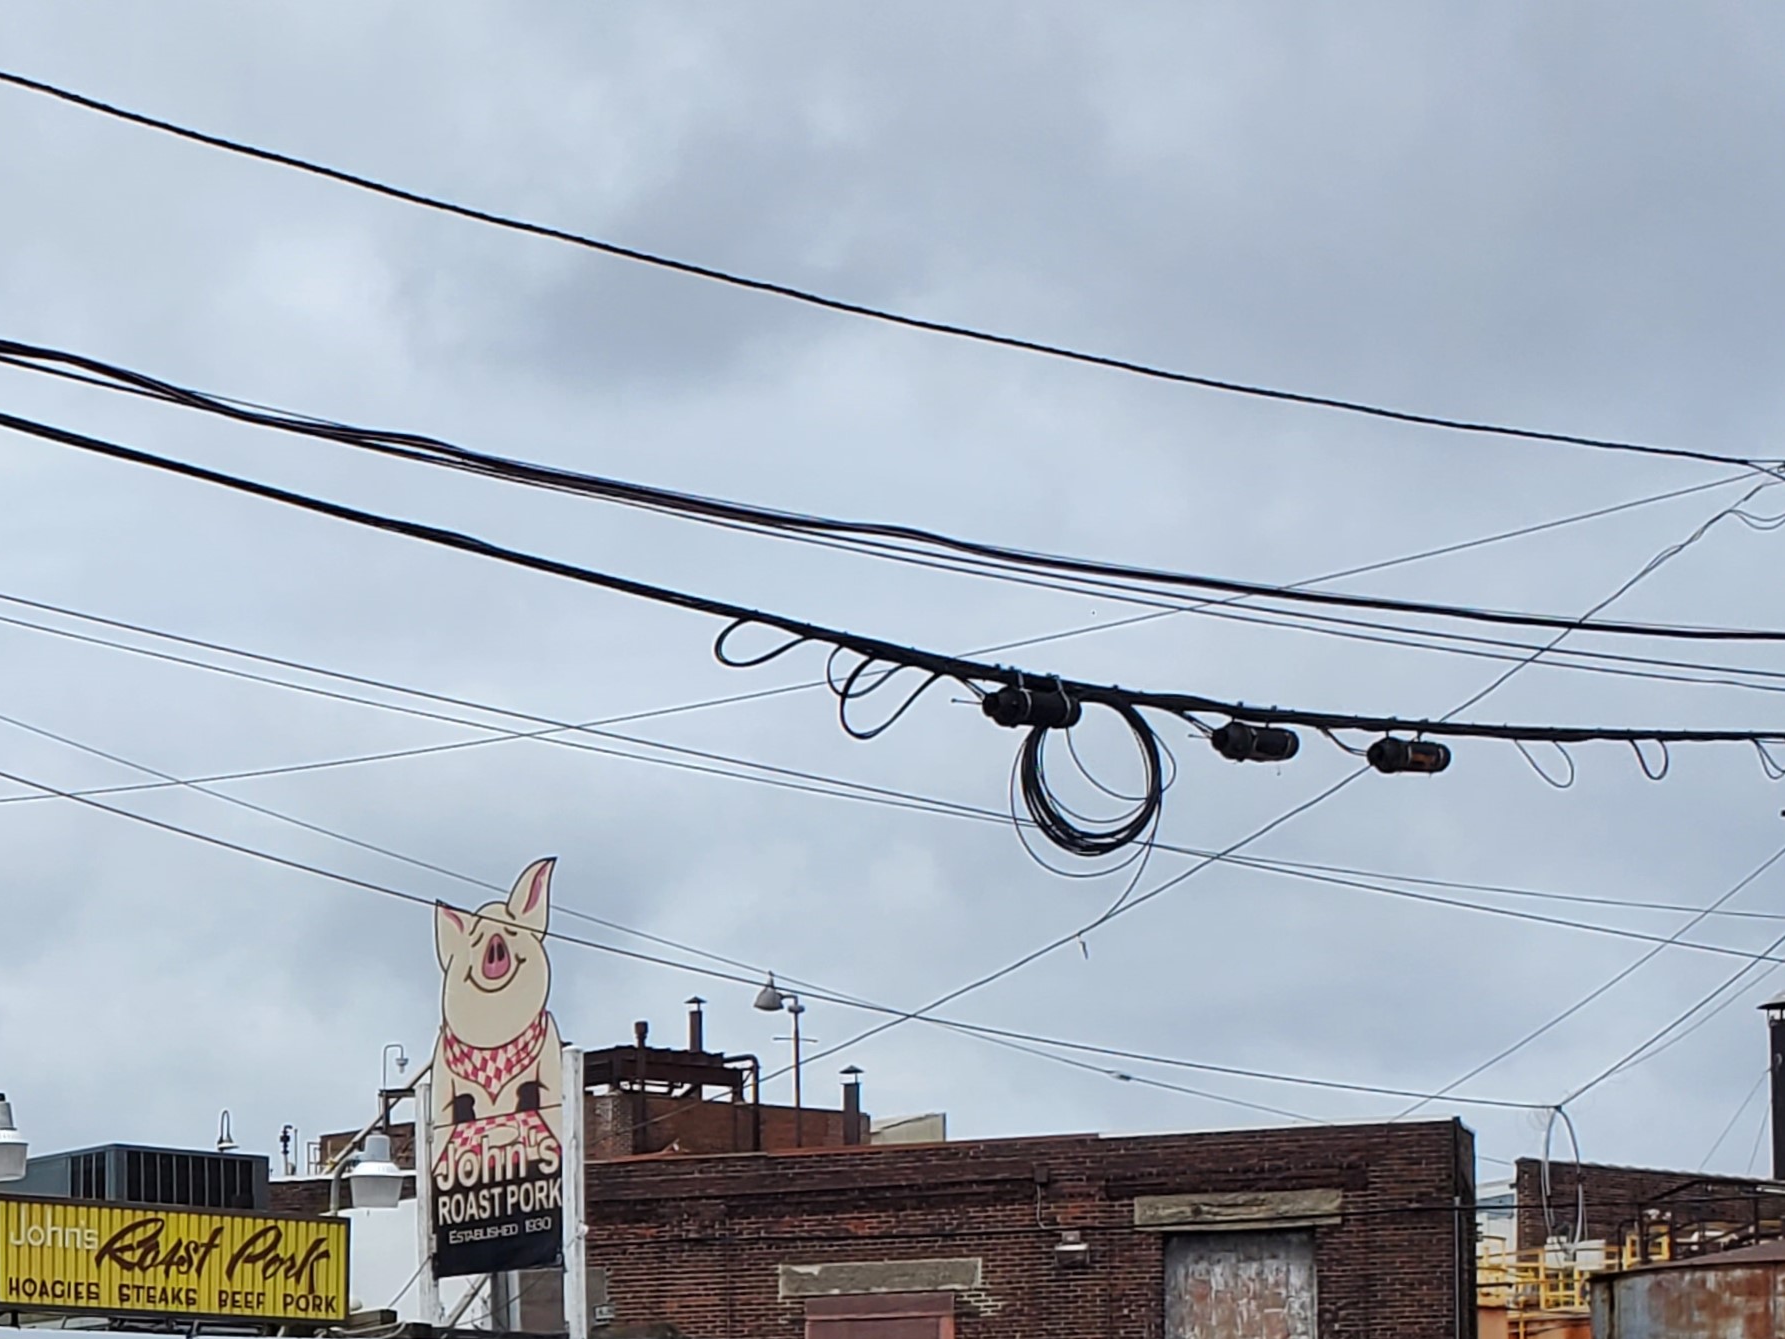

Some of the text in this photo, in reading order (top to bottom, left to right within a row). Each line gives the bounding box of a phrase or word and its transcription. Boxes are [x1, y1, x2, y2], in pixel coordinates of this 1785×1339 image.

[435, 1126, 560, 1191] John's
[438, 1178, 562, 1226] ROAST PORK
[525, 1217, 551, 1233] 1930
[9, 1207, 331, 1294] John's Roast Pork
[9, 1278, 336, 1313] HOAGIES STEAKS BEEF PORK
